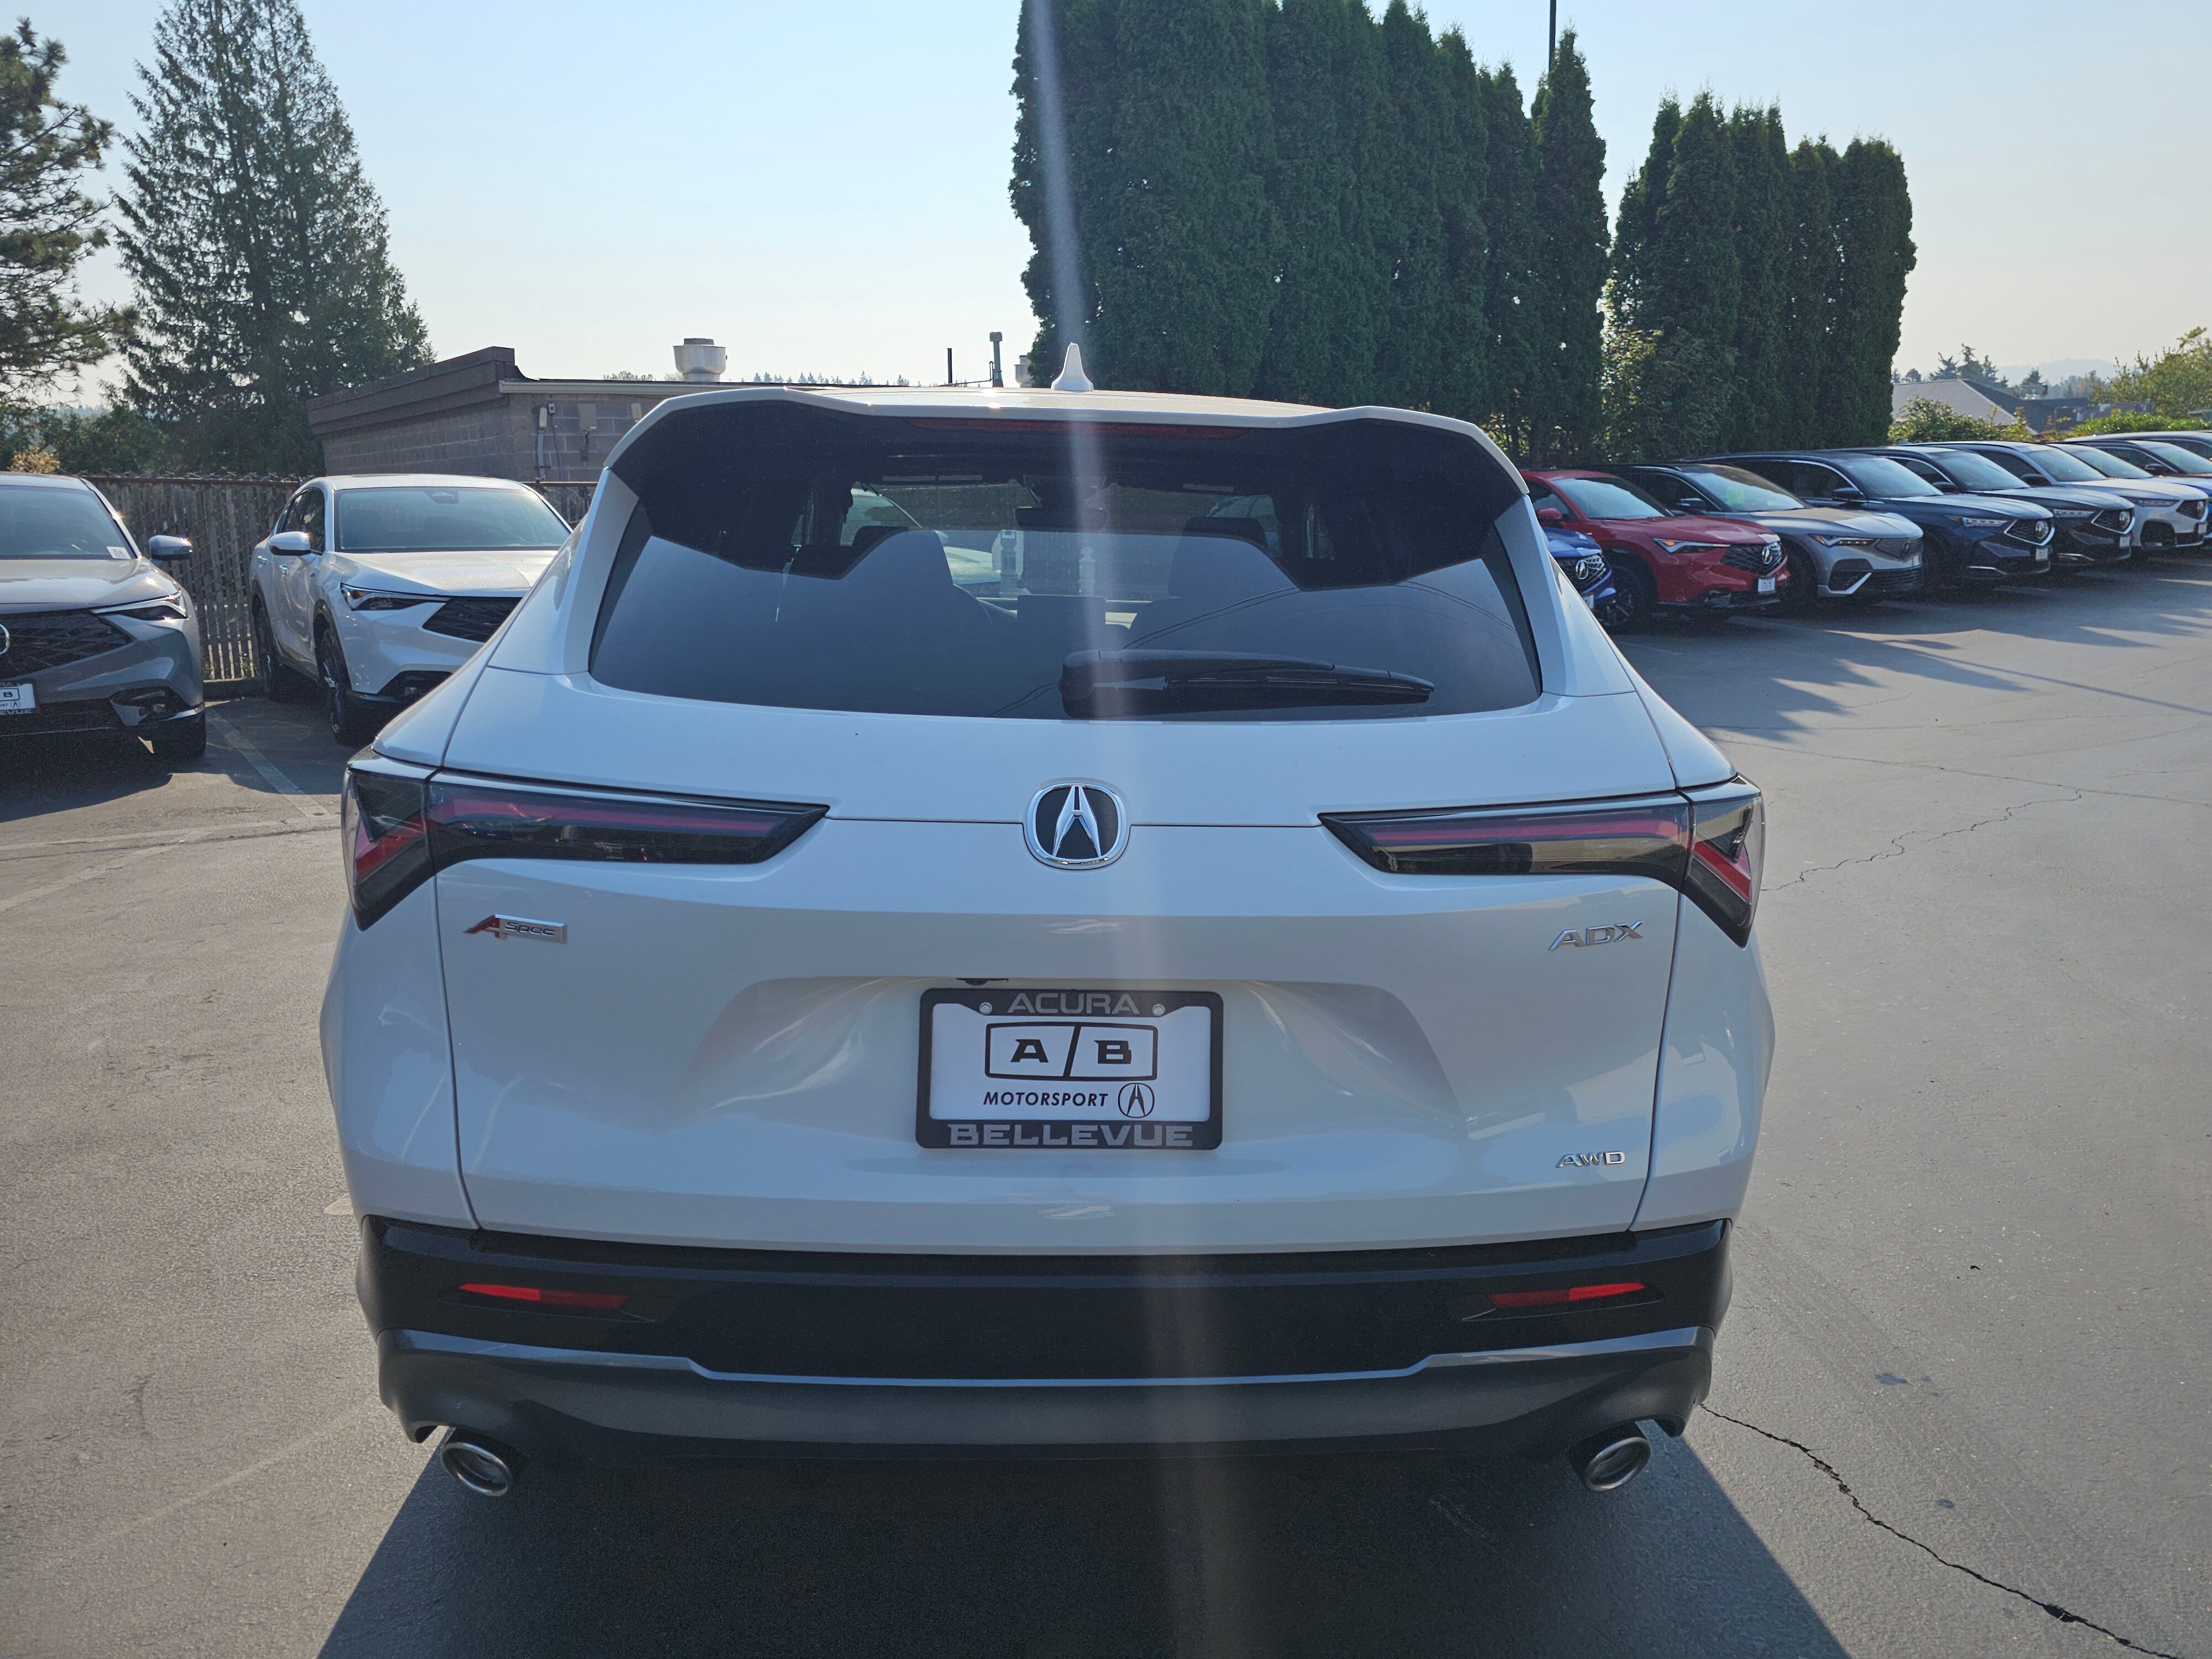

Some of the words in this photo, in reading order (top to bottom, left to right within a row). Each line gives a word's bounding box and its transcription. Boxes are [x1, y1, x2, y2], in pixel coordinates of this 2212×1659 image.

[1548, 920, 1645, 951] ADX
[1007, 993, 1140, 1015] ACURA
[983, 1092, 1108, 1107] MOTORSPORT
[947, 1124, 1193, 1147] BELLEVUE
[1556, 1151, 1625, 1168] AWD
